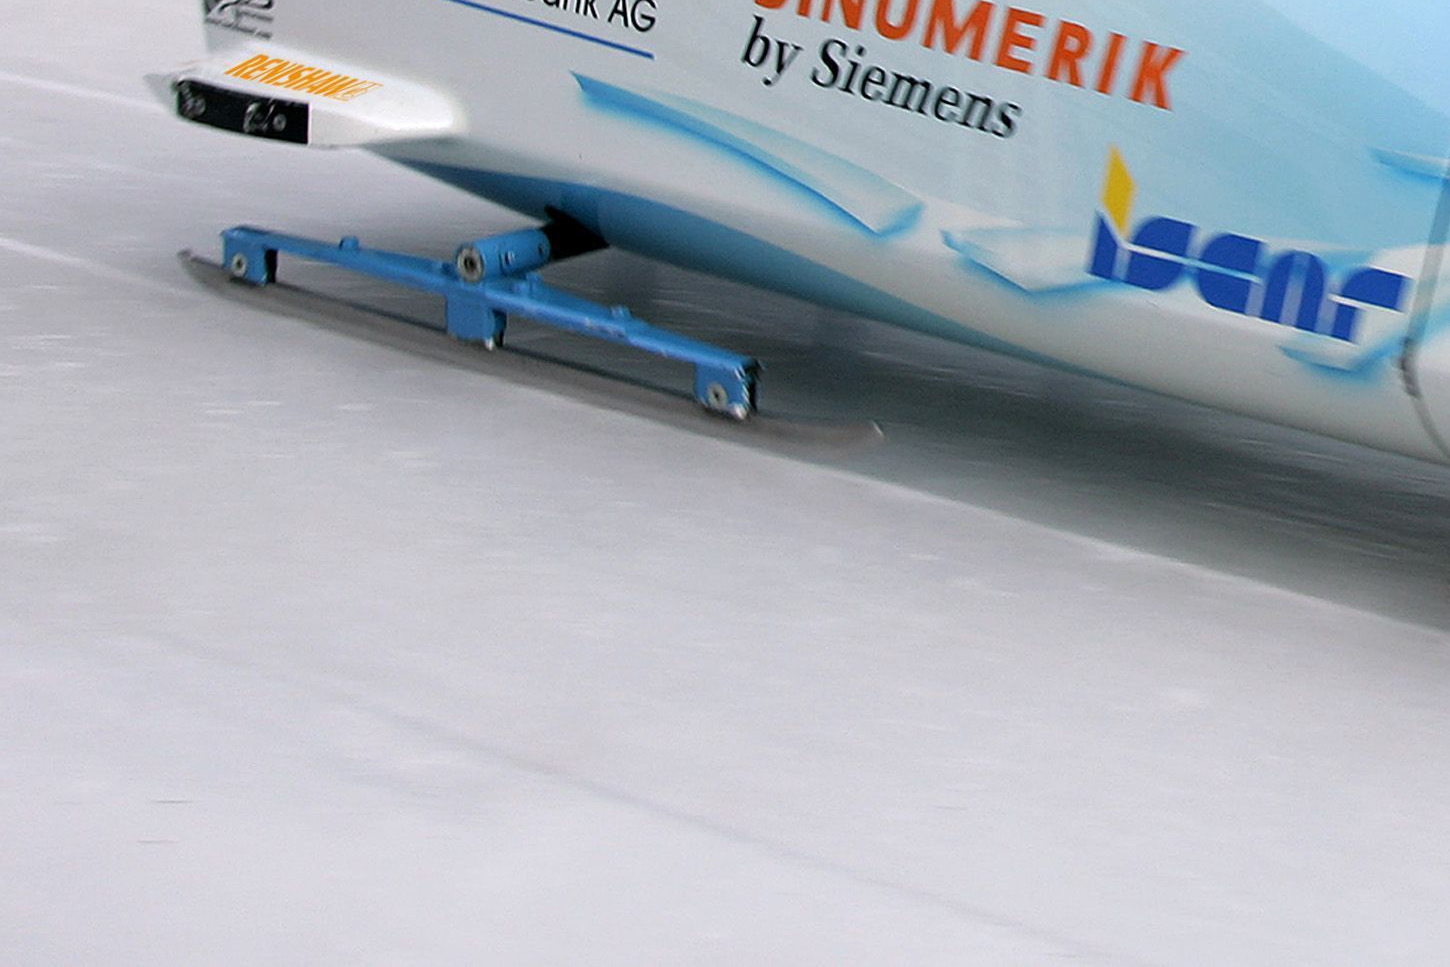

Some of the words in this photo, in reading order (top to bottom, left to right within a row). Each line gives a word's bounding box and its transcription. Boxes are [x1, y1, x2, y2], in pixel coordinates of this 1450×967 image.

[224, 54, 360, 98] RENISHAW
[740, 14, 803, 87] by
[810, 38, 1023, 139] Siemens
